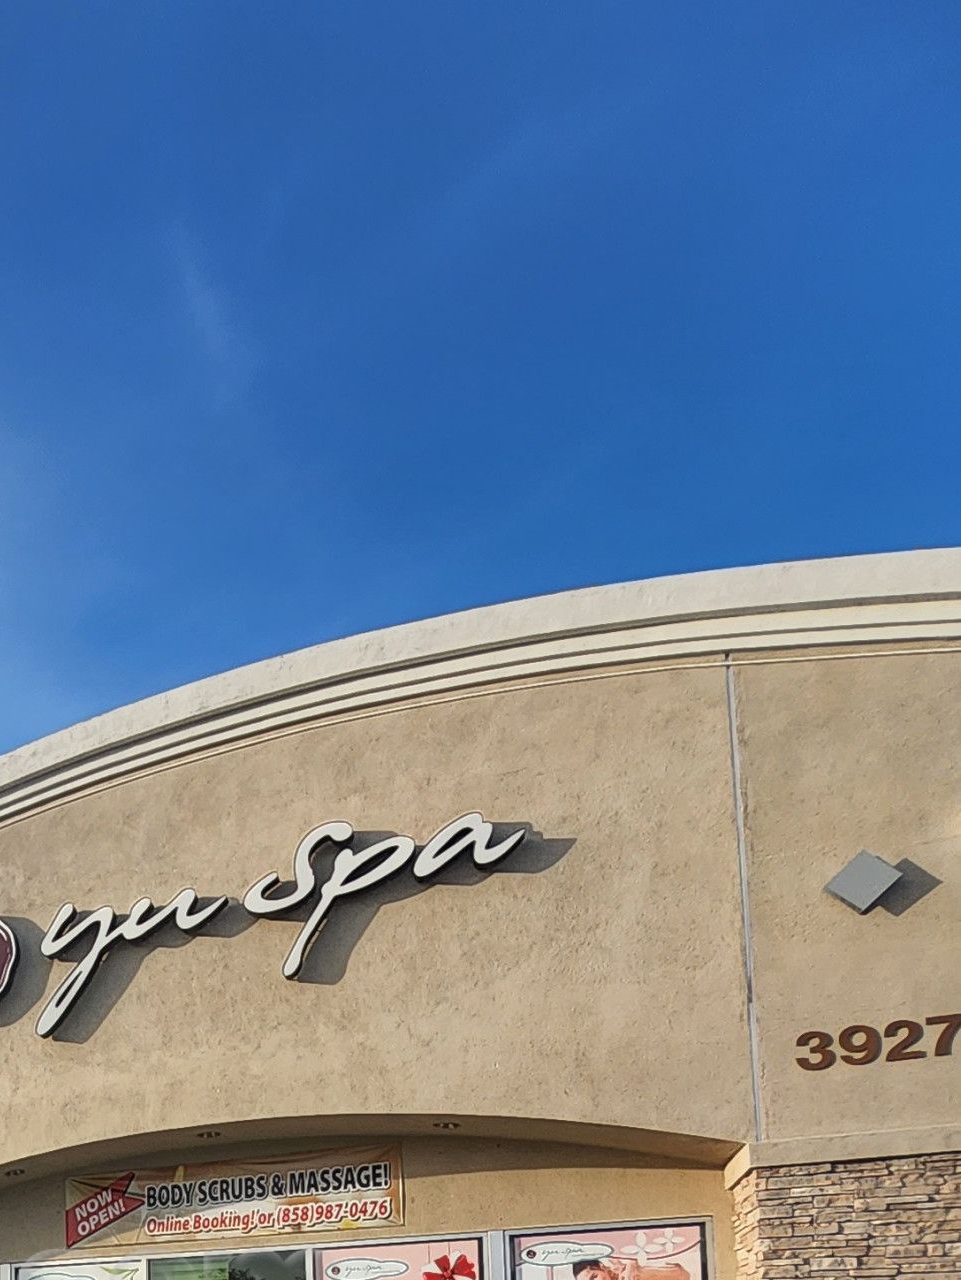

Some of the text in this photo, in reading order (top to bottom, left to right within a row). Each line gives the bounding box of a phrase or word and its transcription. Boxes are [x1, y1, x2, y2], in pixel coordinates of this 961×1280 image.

[35, 888, 228, 1038] yu
[796, 1013, 961, 1071] 3927
[75, 1187, 113, 1220] NOW
[146, 1163, 390, 1208] BODY SCRUBS & MASSAGE!
[77, 1198, 126, 1236] OPEN!
[146, 1200, 389, 1235] Online Booking! or (858)987-0476
